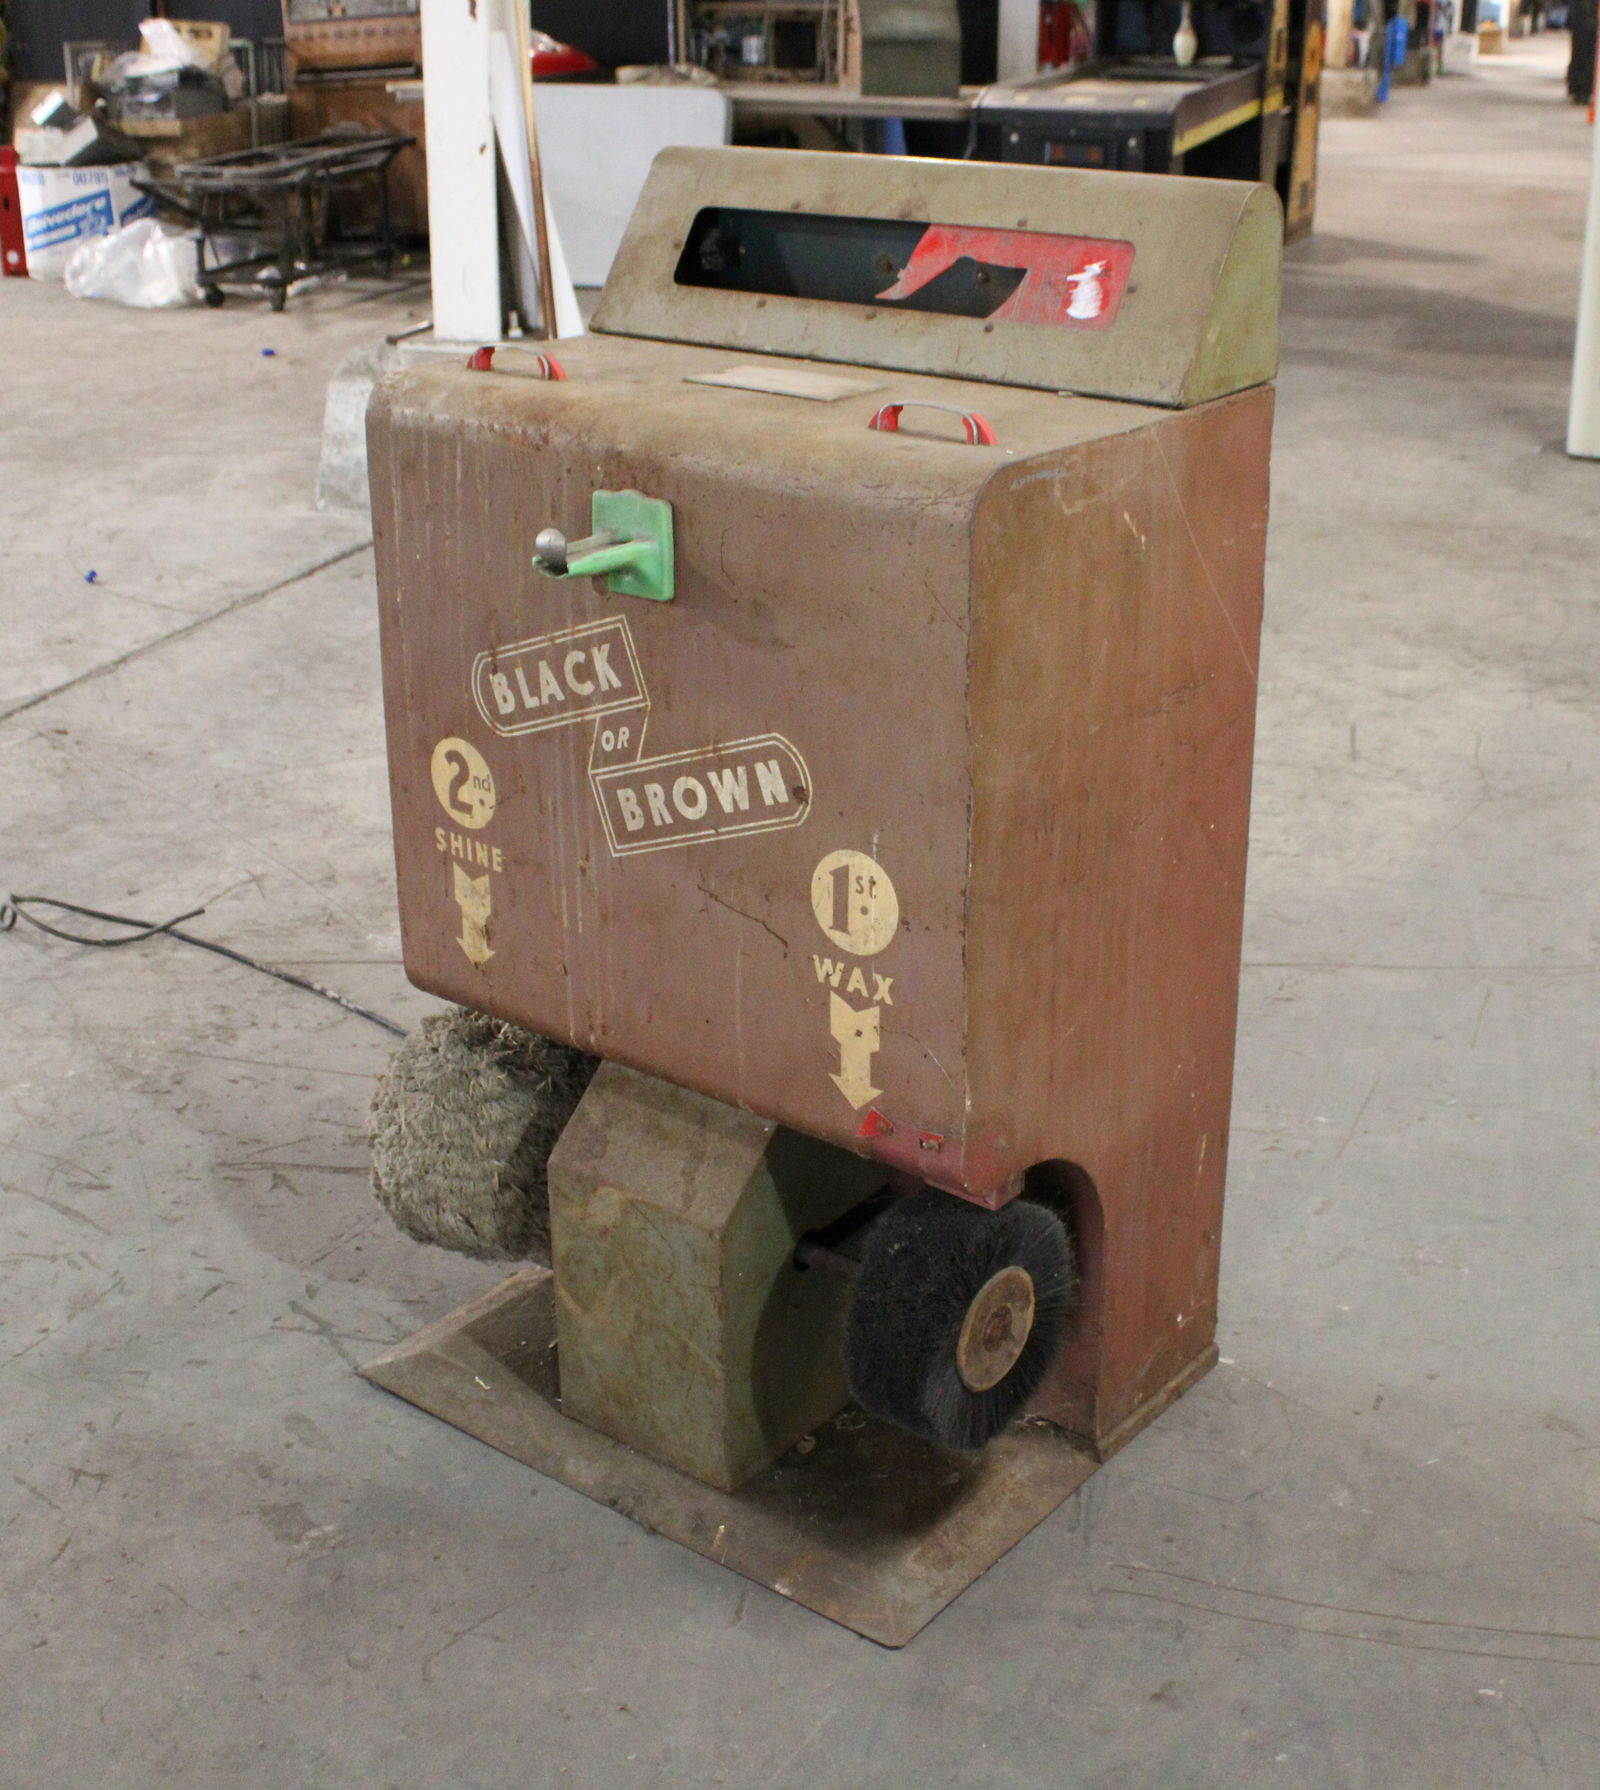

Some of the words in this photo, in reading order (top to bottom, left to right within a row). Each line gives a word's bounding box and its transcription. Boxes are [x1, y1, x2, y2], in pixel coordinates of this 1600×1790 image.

[490, 643, 622, 715] BLACK
[601, 726, 630, 752] OR
[616, 759, 789, 832] BROWN
[435, 827, 504, 873] SHINE
[812, 954, 894, 1006] WAX
